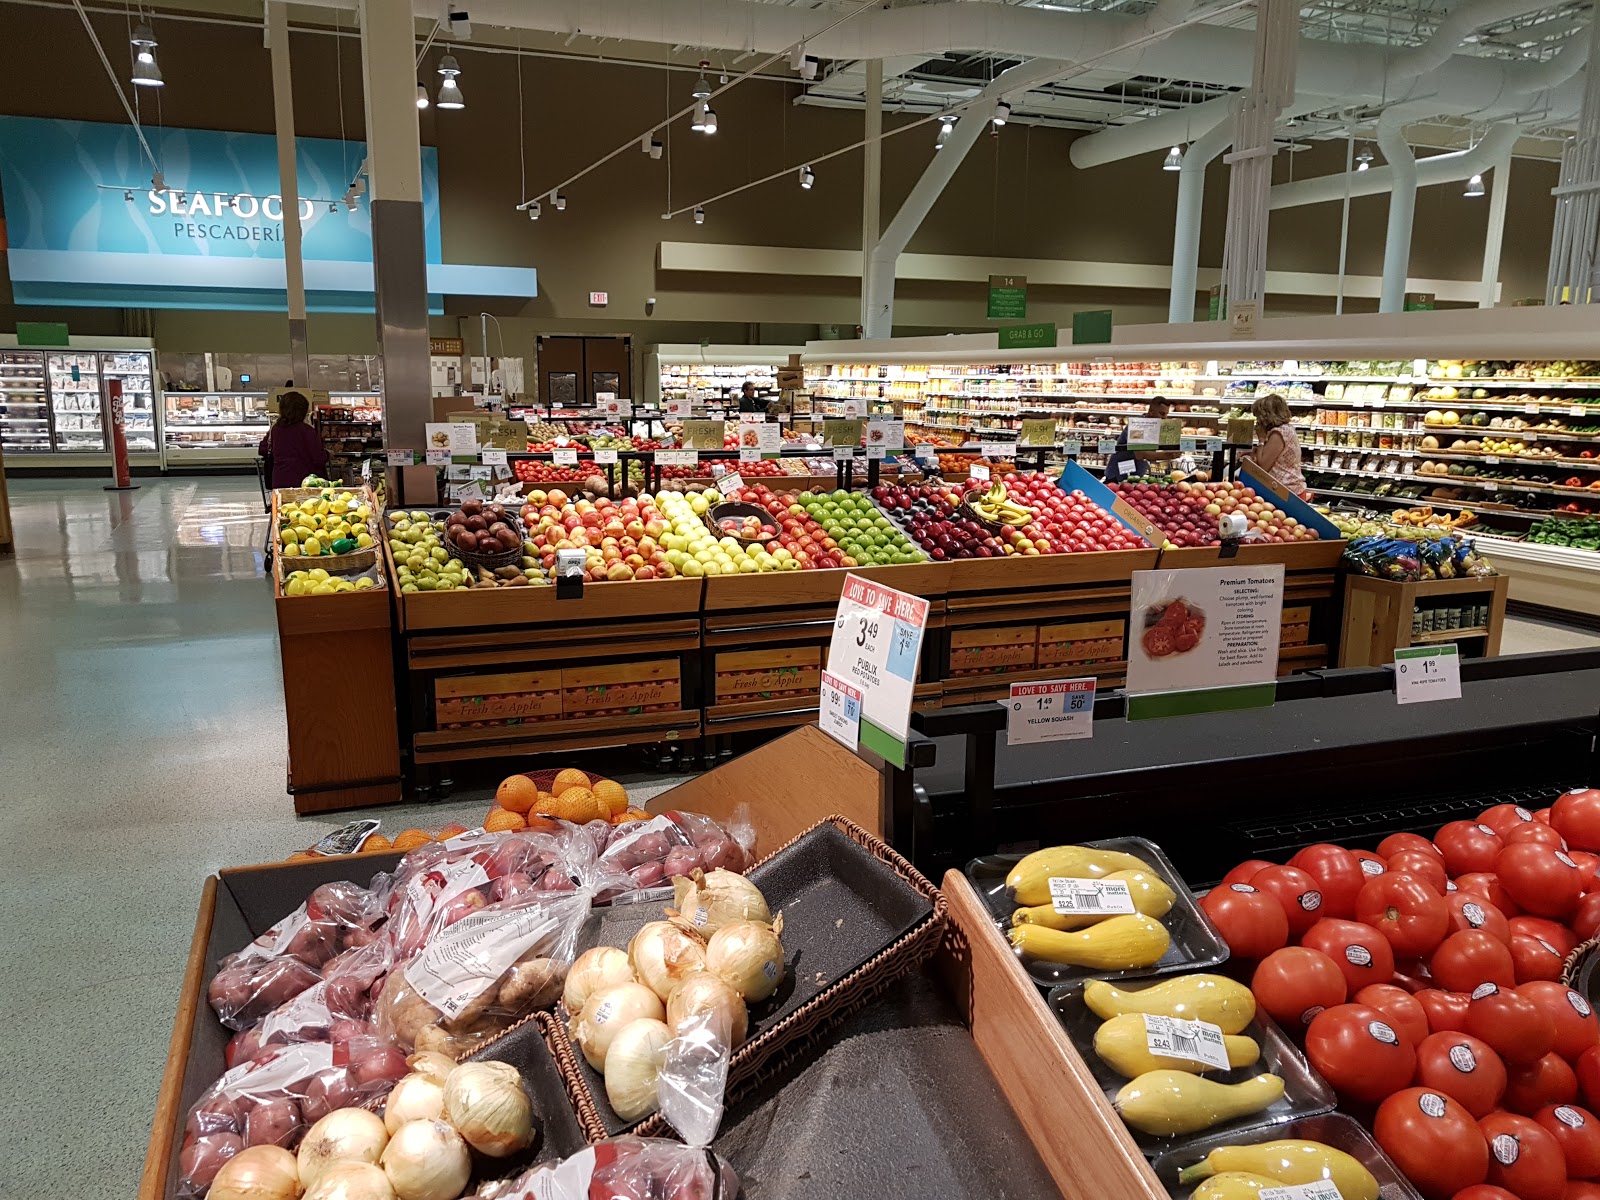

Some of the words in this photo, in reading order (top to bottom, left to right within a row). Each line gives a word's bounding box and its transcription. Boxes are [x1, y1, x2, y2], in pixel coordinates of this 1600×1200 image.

[148, 189, 314, 221] SEAFOOD
[174, 222, 286, 242] PESCADERÍ
[1004, 278, 1014, 286] 14
[594, 293, 605, 303] EXIT
[1009, 330, 1027, 340] GRAB
[1028, 330, 1032, 338] &
[1033, 328, 1044, 338] GO
[430, 342, 445, 351] SHI
[486, 428, 517, 437] FRESH
[687, 427, 716, 435] FRESH
[827, 426, 854, 434] FRESH
[1025, 425, 1049, 433] FRESH
[1220, 578, 1246, 586] Premium
[850, 582, 864, 600] LOVE
[866, 588, 876, 605] TO
[878, 593, 892, 612] SAVE
[895, 600, 915, 621] HERE.
[900, 628, 913, 640] SAVE
[864, 643, 876, 653] EACH
[963, 654, 984, 664] Fresh
[998, 652, 1022, 662] Apples
[857, 658, 878, 676] PUBLIX
[852, 666, 860, 675] RED
[860, 671, 880, 686] POTATOES
[734, 678, 758, 689] Fresh
[774, 676, 803, 688] Apples
[1018, 686, 1035, 696] LOVE
[1038, 686, 1048, 694] TO
[1050, 684, 1066, 692] SAVE
[1070, 682, 1088, 692] HERE.
[585, 693, 612, 705] Fresh
[630, 690, 662, 702] Apples
[460, 704, 488, 716] Fresh
[508, 702, 542, 714] Apples
[1202, 1030, 1222, 1040] more
[1317, 1192, 1339, 1200] more
